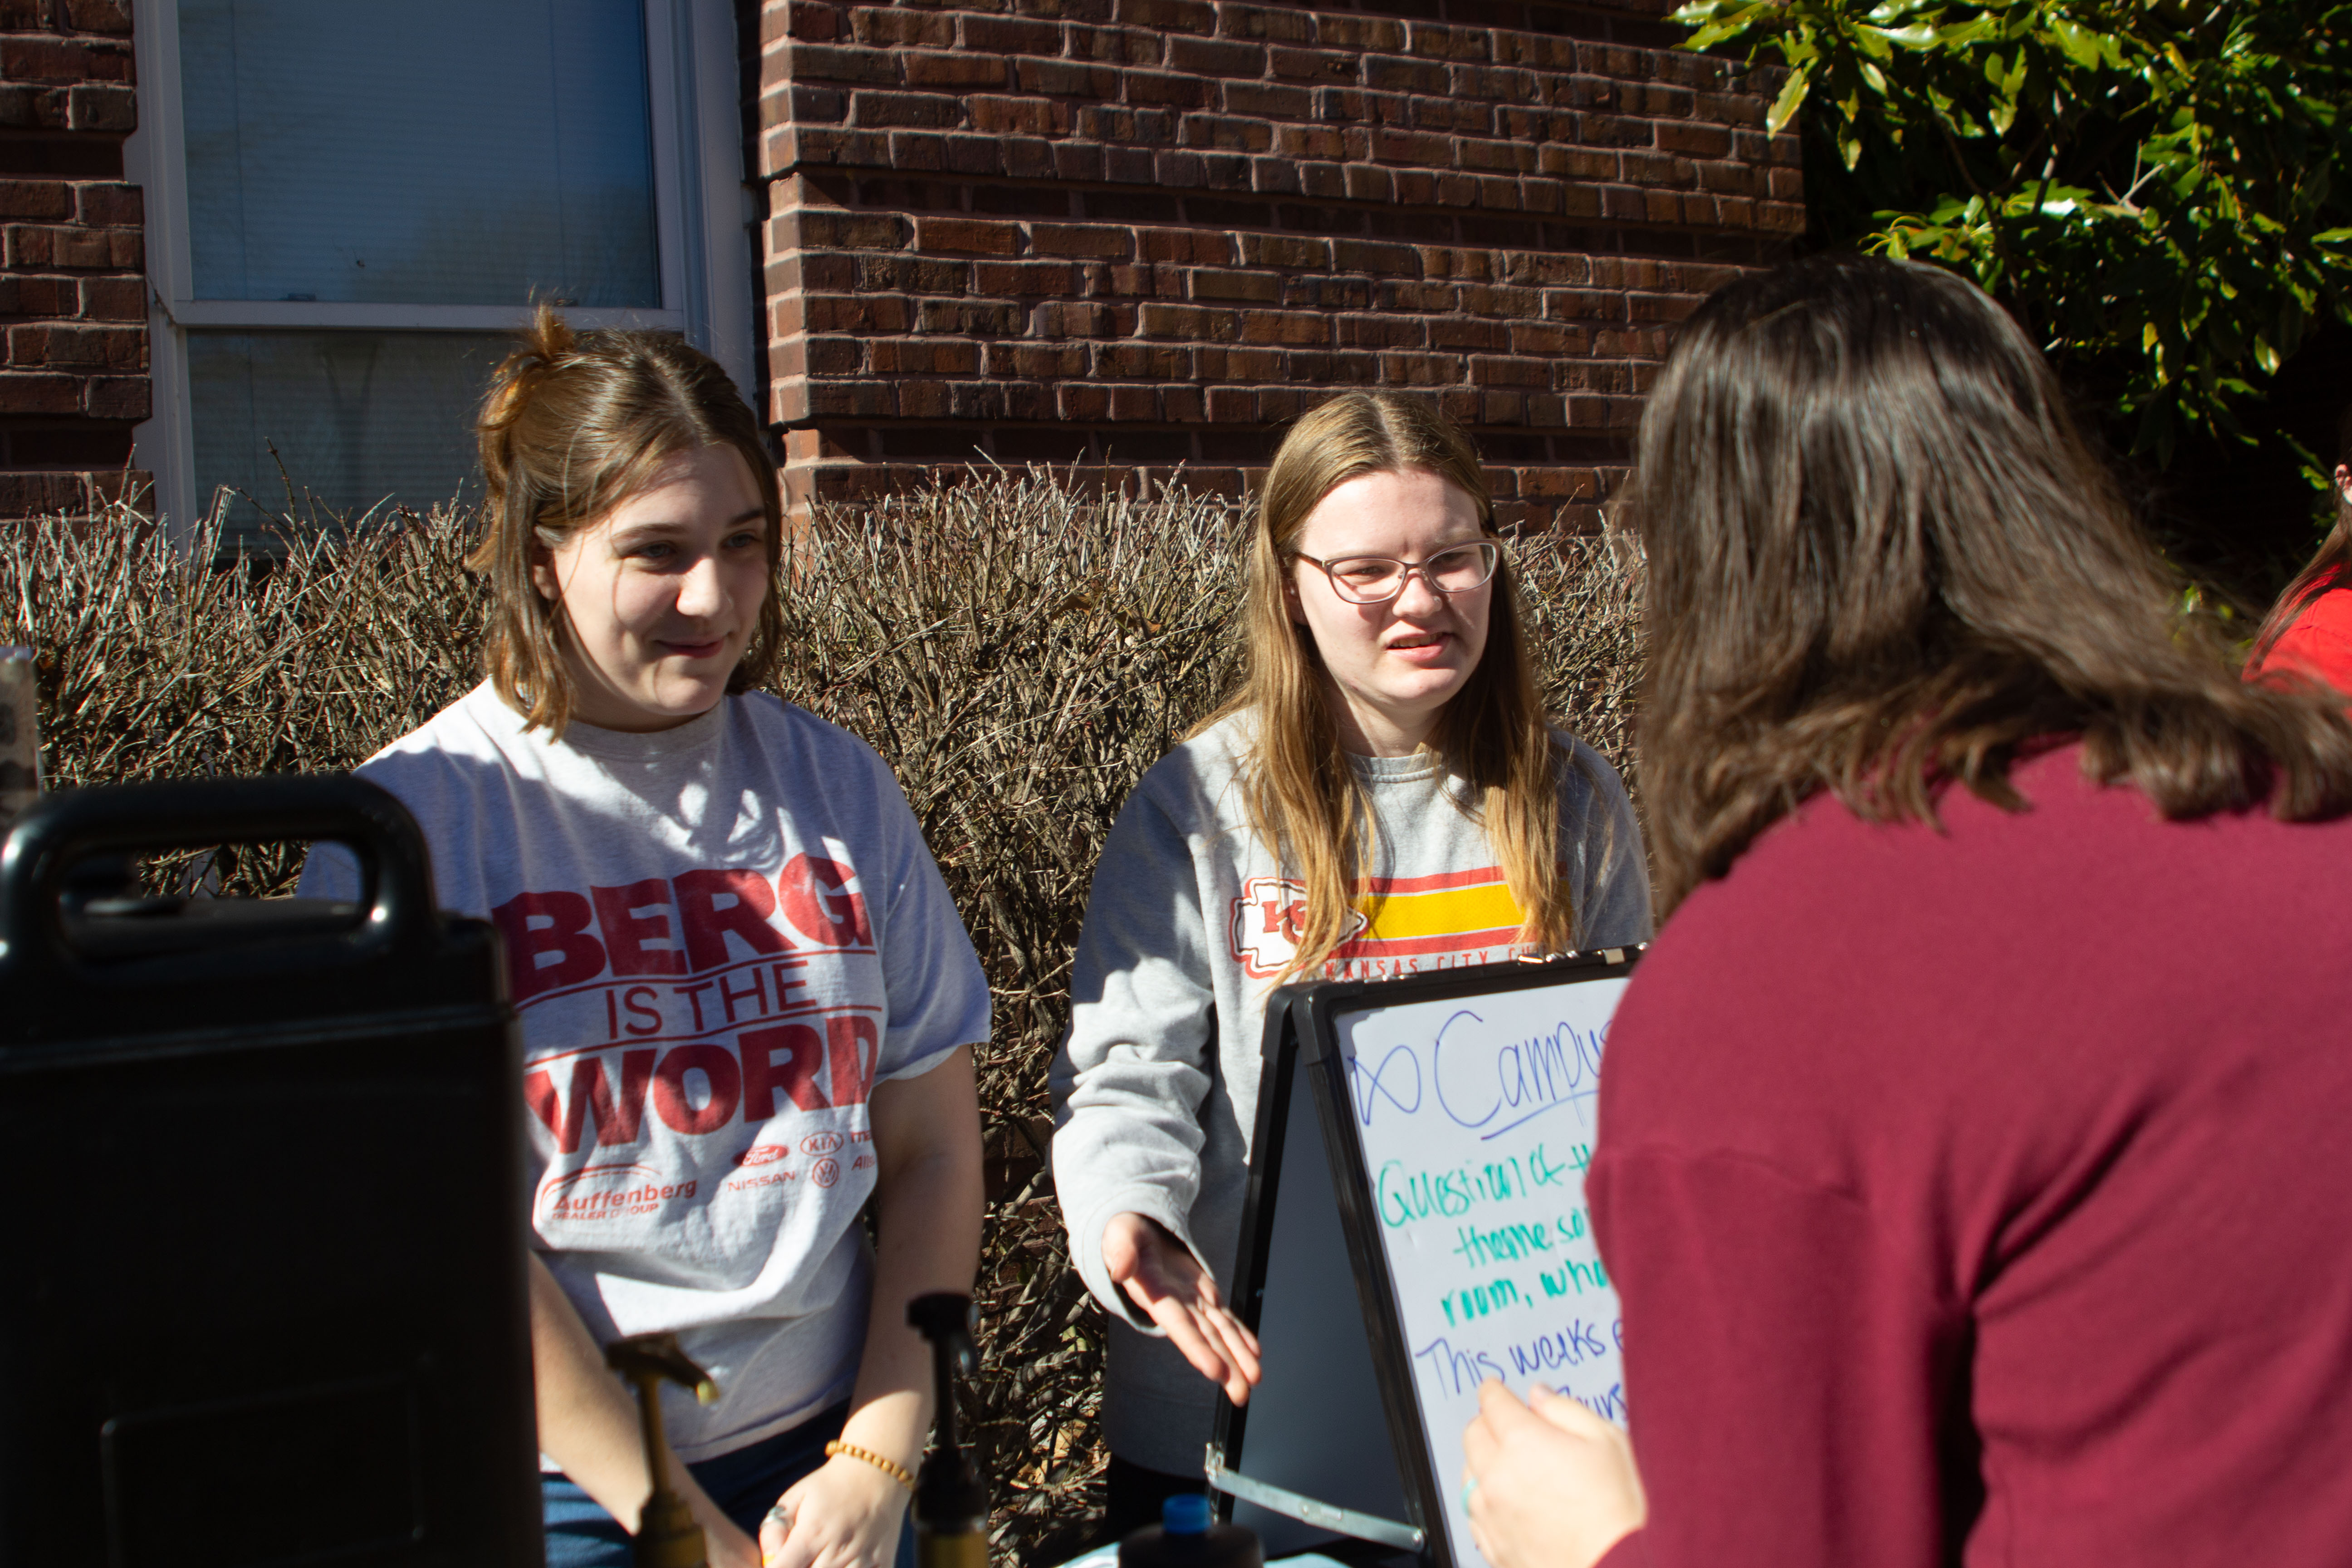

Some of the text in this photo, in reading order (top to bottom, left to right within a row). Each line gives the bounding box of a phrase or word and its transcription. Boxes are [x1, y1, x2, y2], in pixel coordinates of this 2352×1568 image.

[492, 852, 873, 1004] BERG
[1325, 957, 1418, 980] KANSAS
[1437, 951, 1488, 970] CITY
[607, 960, 817, 1040] IS THE
[524, 1016, 878, 1153] WORD
[743, 1147, 779, 1166] Ford
[553, 1180, 697, 1210] Auffenberg
[728, 1171, 795, 1191] NISSAN
[1379, 1157, 1527, 1225] Question
[552, 1210, 606, 1220] DEALER
[1415, 1338, 1505, 1400] This
